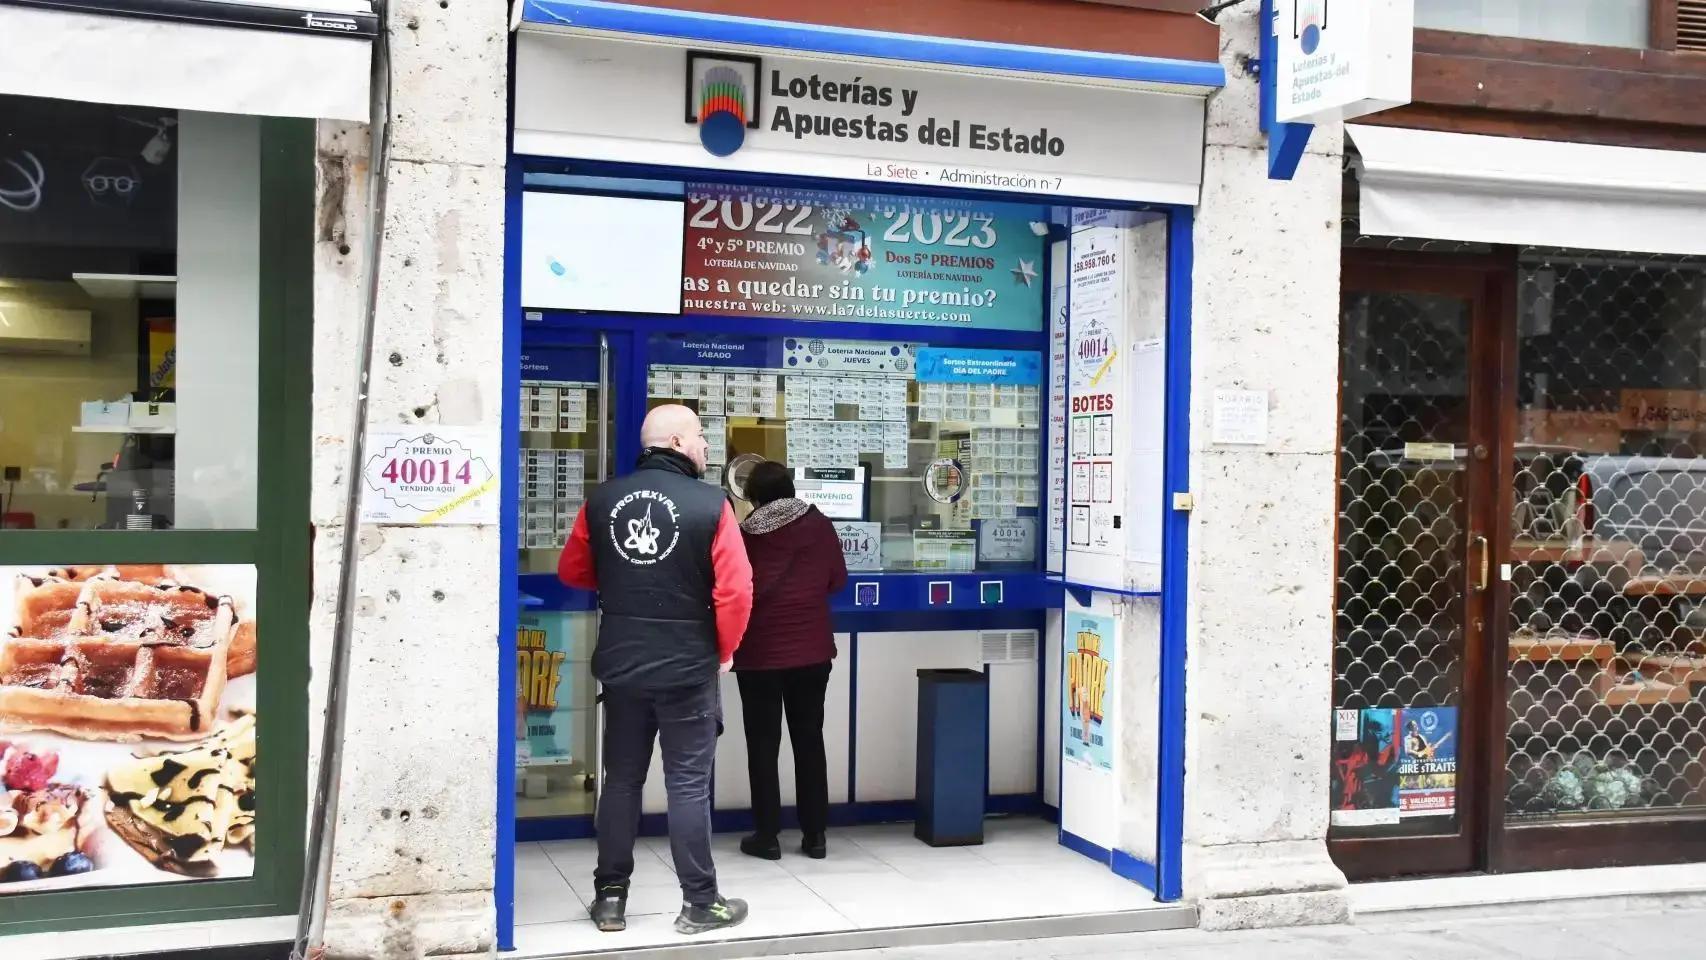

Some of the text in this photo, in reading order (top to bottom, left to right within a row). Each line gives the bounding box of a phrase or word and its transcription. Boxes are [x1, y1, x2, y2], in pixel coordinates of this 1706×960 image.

[771, 70, 918, 116] Loterías y
[1292, 87, 1322, 104] Estado
[770, 105, 1065, 156] Apuestas del Estado
[867, 163, 882, 176] La
[887, 164, 918, 180] Siete
[939, 169, 1036, 189] Administración
[689, 197, 814, 236] 2022
[883, 206, 998, 249] 2023
[697, 237, 805, 256] 4º y 5º PREMIO
[704, 257, 798, 272] LOTERÍA DE NAVIDAD
[885, 250, 995, 271] Dos 5º PREMIOS
[896, 269, 983, 283] LOTERÍA DE NAVIDAD
[683, 276, 998, 309] as a quedar sin tu premio?
[684, 298, 972, 323] nuestra web: www.la7delasuerte.com
[697, 349, 732, 359] SÁBADO
[711, 342, 745, 351] Nacional
[854, 348, 887, 356] Nacional
[1078, 337, 1108, 360] 40014
[842, 356, 872, 364] JUEVES
[1072, 393, 1114, 412] BOTES
[412, 446, 452, 456] PREMIO
[381, 458, 472, 485] 40014
[400, 485, 435, 493] VENDIDO
[805, 492, 853, 501] BIENVENIDO
[610, 490, 680, 523] PROTEXVALL
[992, 529, 1026, 537] 40014
[1338, 711, 1356, 721] XIX
[1399, 761, 1457, 774] dIRE sTRAITS
